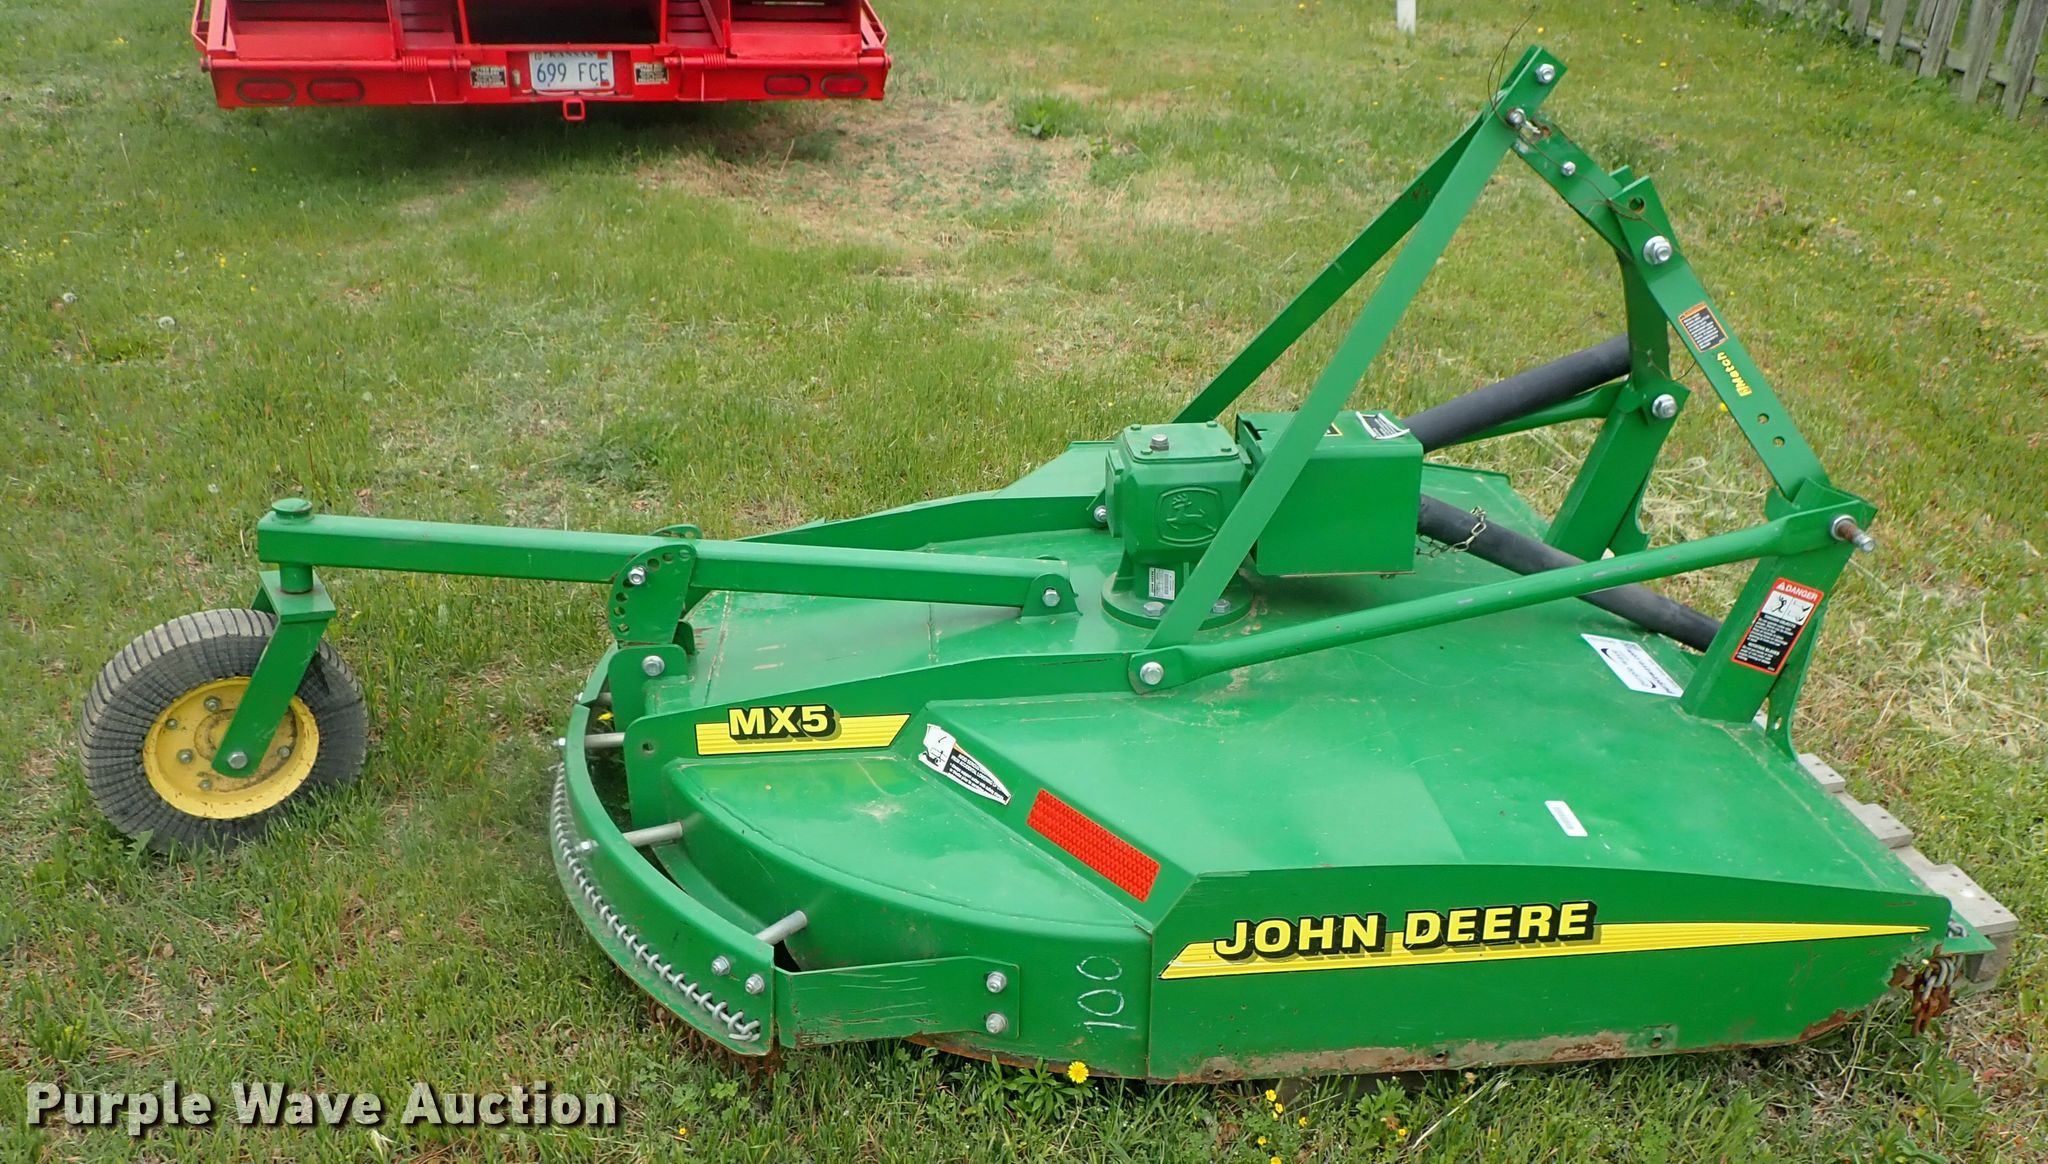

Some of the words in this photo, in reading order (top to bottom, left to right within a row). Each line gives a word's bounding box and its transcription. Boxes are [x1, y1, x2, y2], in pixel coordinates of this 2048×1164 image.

[537, 62, 567, 83] 699
[578, 62, 609, 82] FCE
[1784, 584, 1818, 603] DANGER
[728, 704, 836, 741] MX5
[1213, 911, 1385, 961] JOHN
[1403, 900, 1597, 953] DEERE
